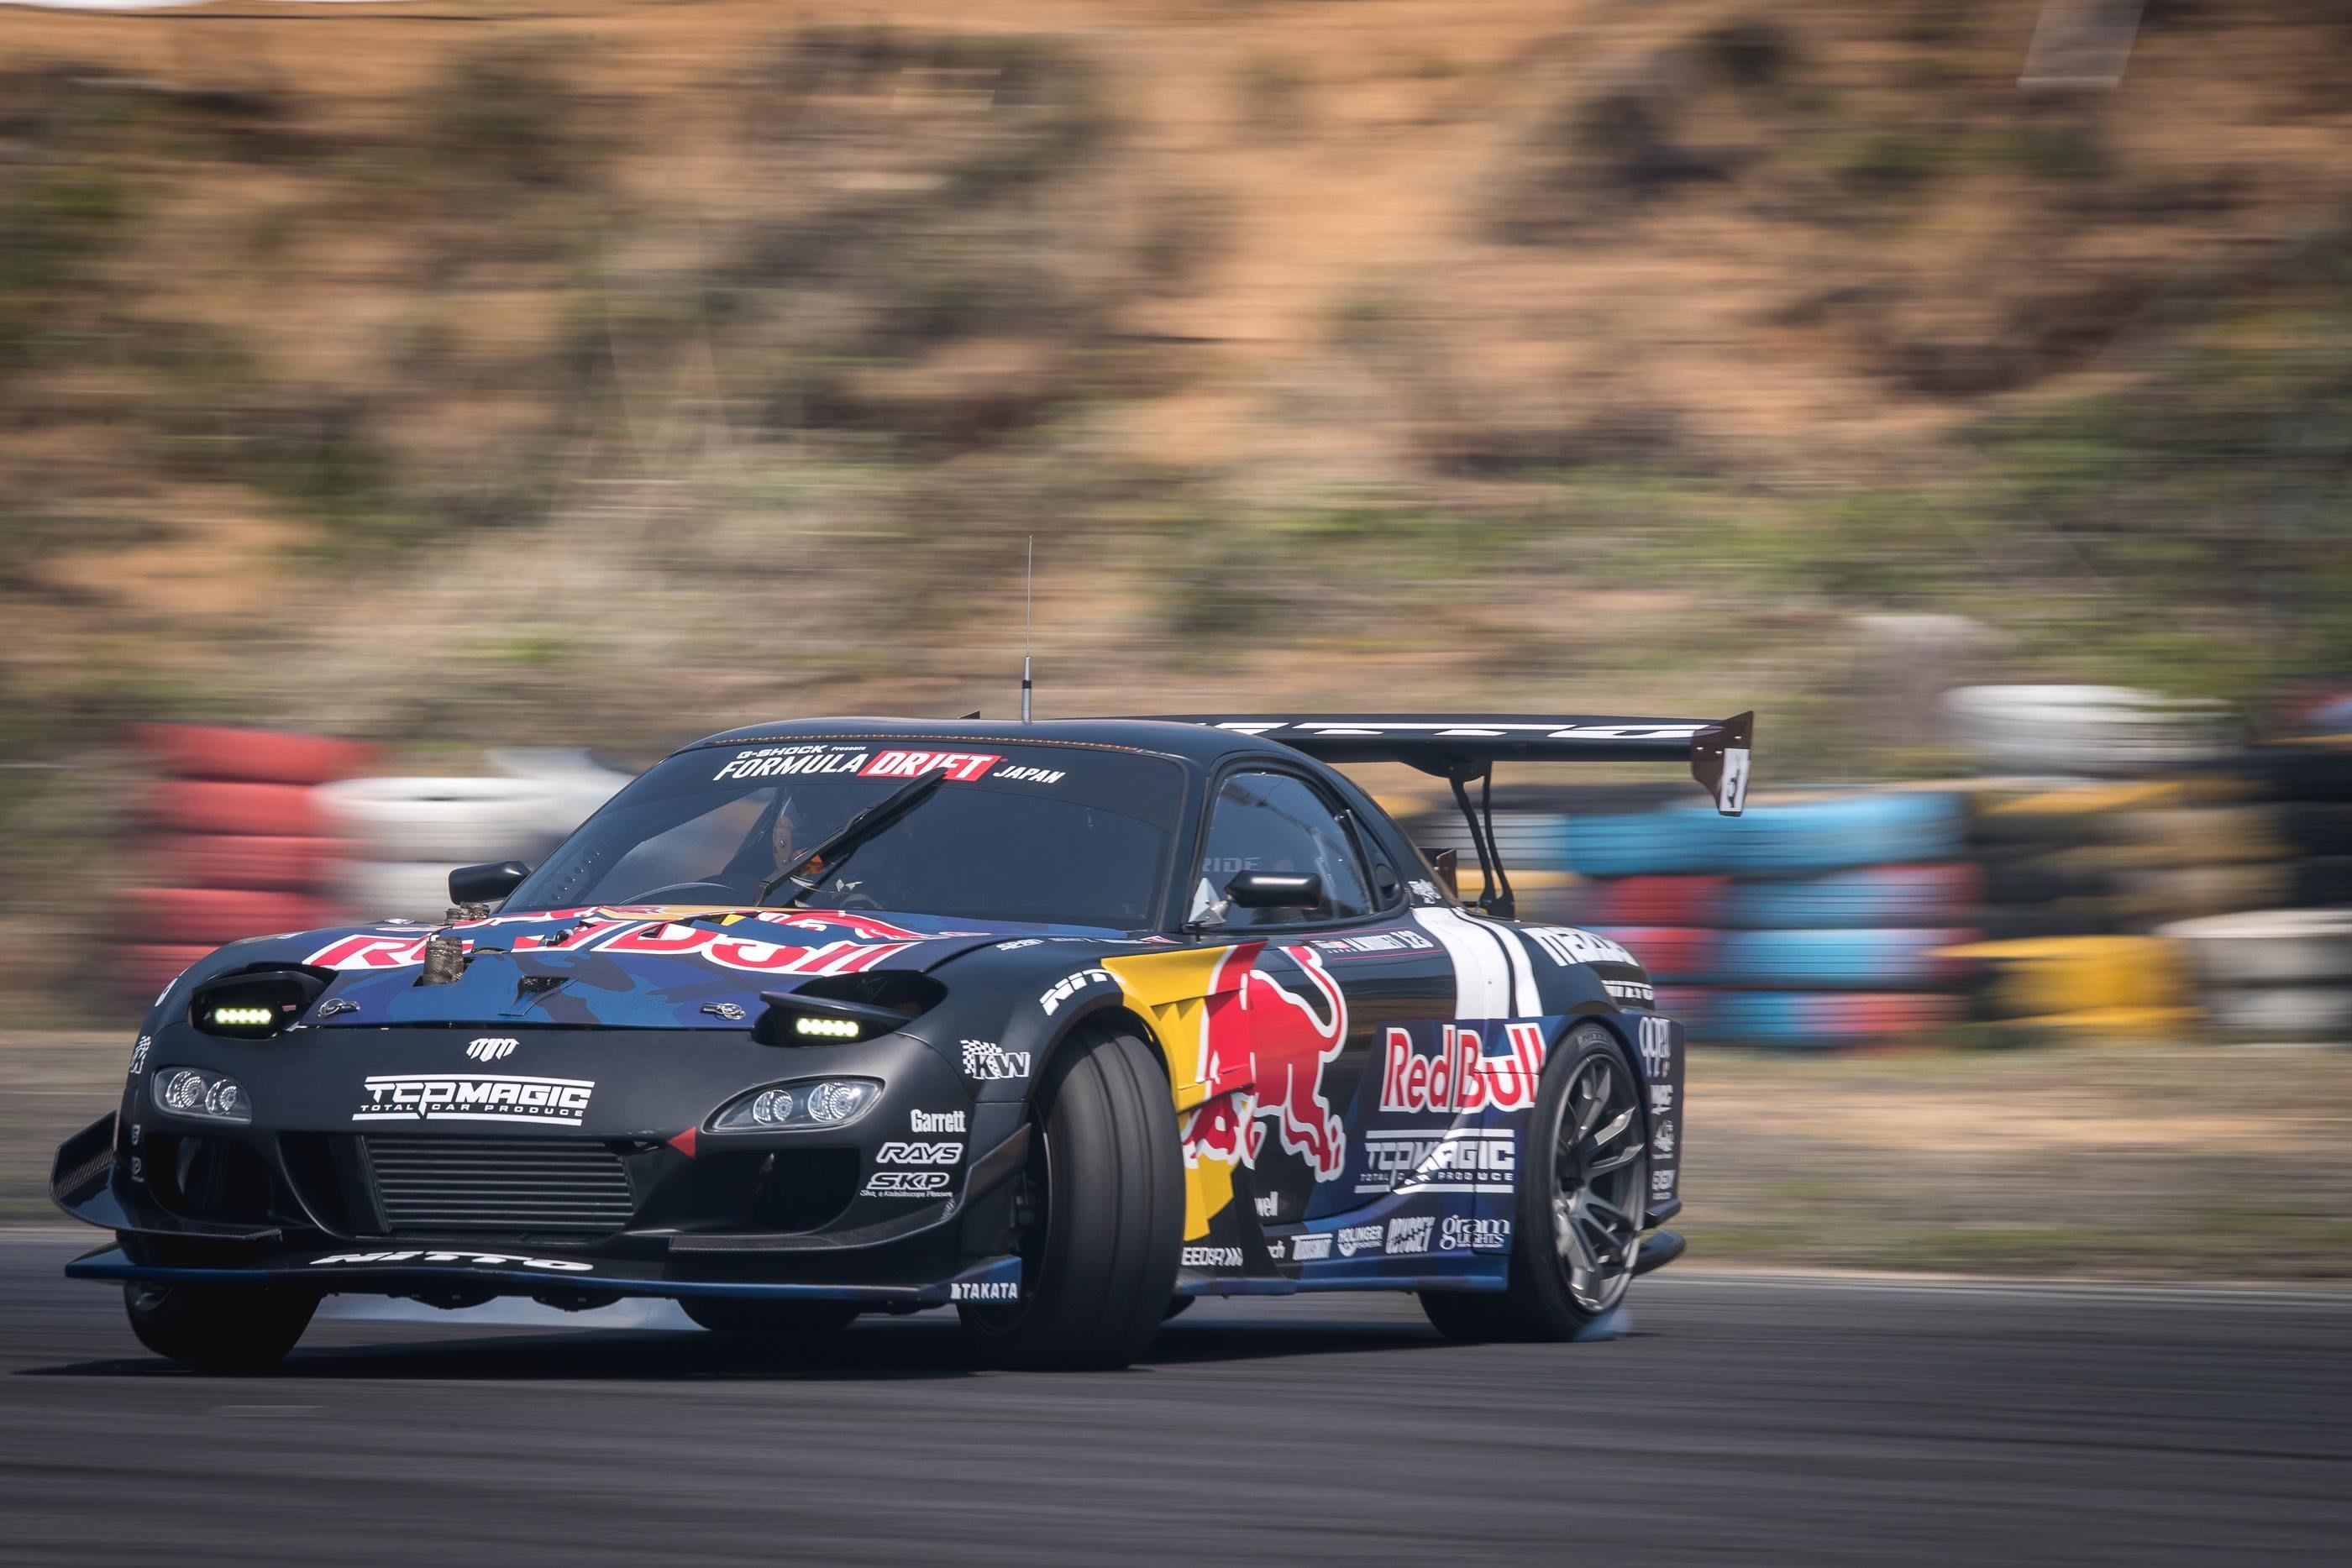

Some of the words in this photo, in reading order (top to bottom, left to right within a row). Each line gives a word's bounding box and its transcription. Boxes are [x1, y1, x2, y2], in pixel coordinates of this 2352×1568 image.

[1196, 722, 1724, 738] ITTO
[737, 744, 828, 760] G-SHOCK
[713, 753, 870, 781] FORMULA
[869, 751, 993, 779] DRIFT
[993, 765, 1068, 784] JAPAN
[973, 1051, 1031, 1079] KW
[1379, 1024, 1456, 1114] Red
[1452, 1022, 1547, 1114] Bull
[485, 1104, 584, 1117] PRODUCE
[910, 1109, 966, 1132] Garrett
[876, 1142, 963, 1164] RAYS
[1440, 1214, 1511, 1251] gram
[961, 1282, 1018, 1299] TAKATA
